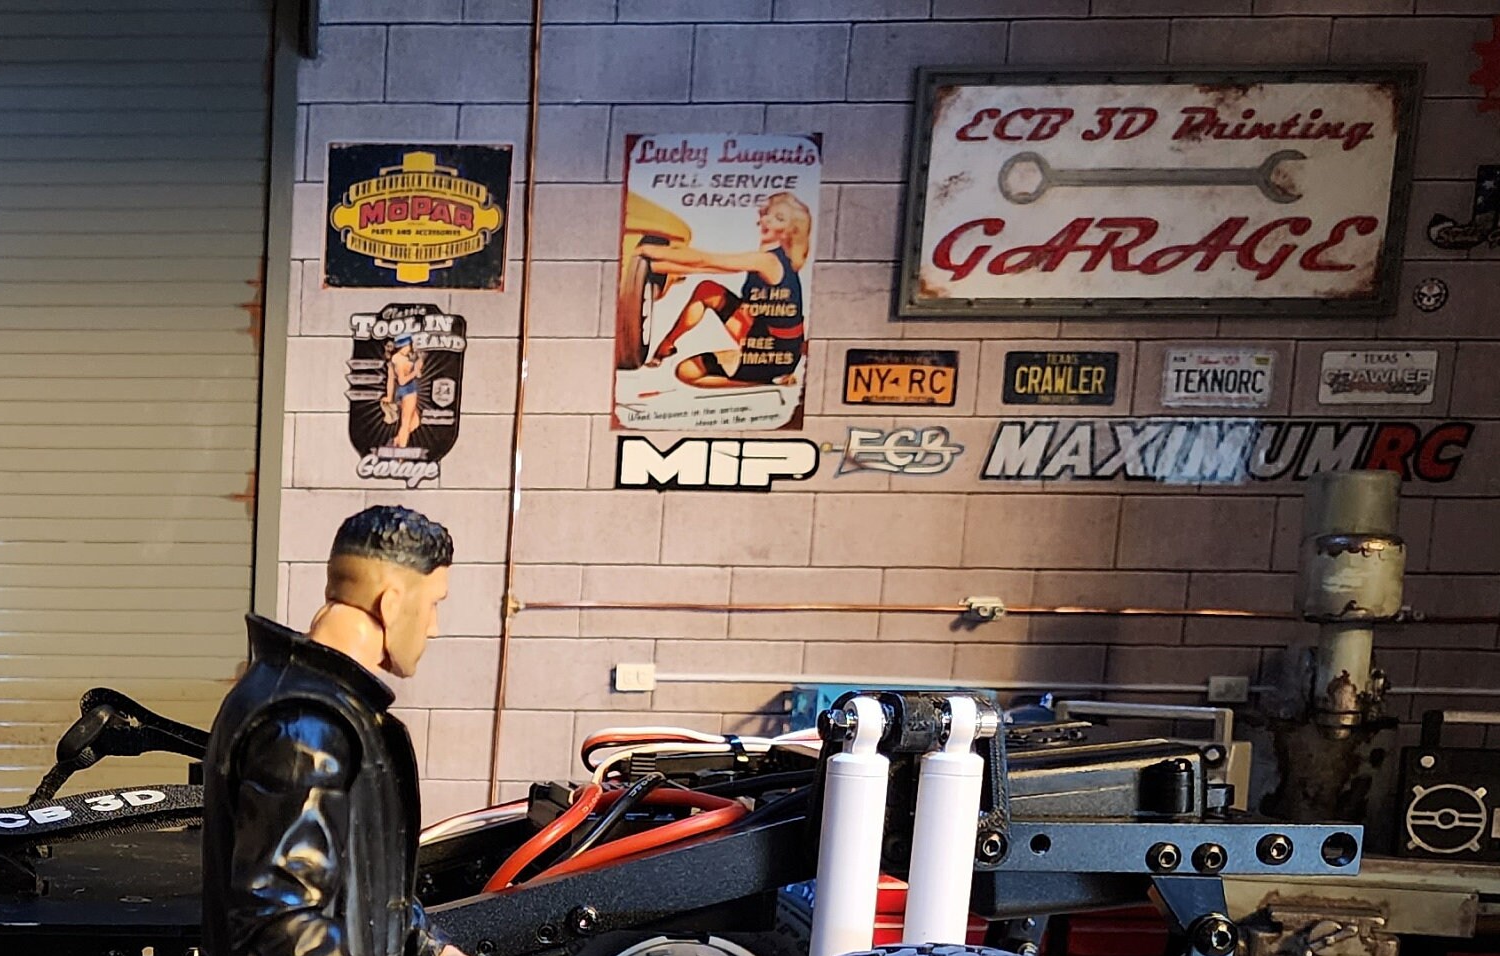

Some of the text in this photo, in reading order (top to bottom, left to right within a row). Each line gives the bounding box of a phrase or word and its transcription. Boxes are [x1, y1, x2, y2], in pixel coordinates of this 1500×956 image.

[956, 107, 1376, 151] ECB 3D Printing
[636, 139, 708, 168] Lucky
[652, 174, 798, 190] FULL SERVICE
[682, 193, 767, 207] GARAGE
[358, 194, 475, 232] MOPAR
[931, 216, 1379, 282] GARAGE
[741, 303, 797, 317] TOWING
[351, 315, 454, 339] TOOL IN
[740, 337, 775, 350] FREE
[738, 352, 794, 366] TIMATES
[1364, 353, 1398, 364] TEXAS
[1015, 366, 1106, 394] CRAWLER
[1173, 368, 1266, 394] TEKNORC
[358, 455, 439, 488] Garage
[84, 789, 166, 812] 3D
